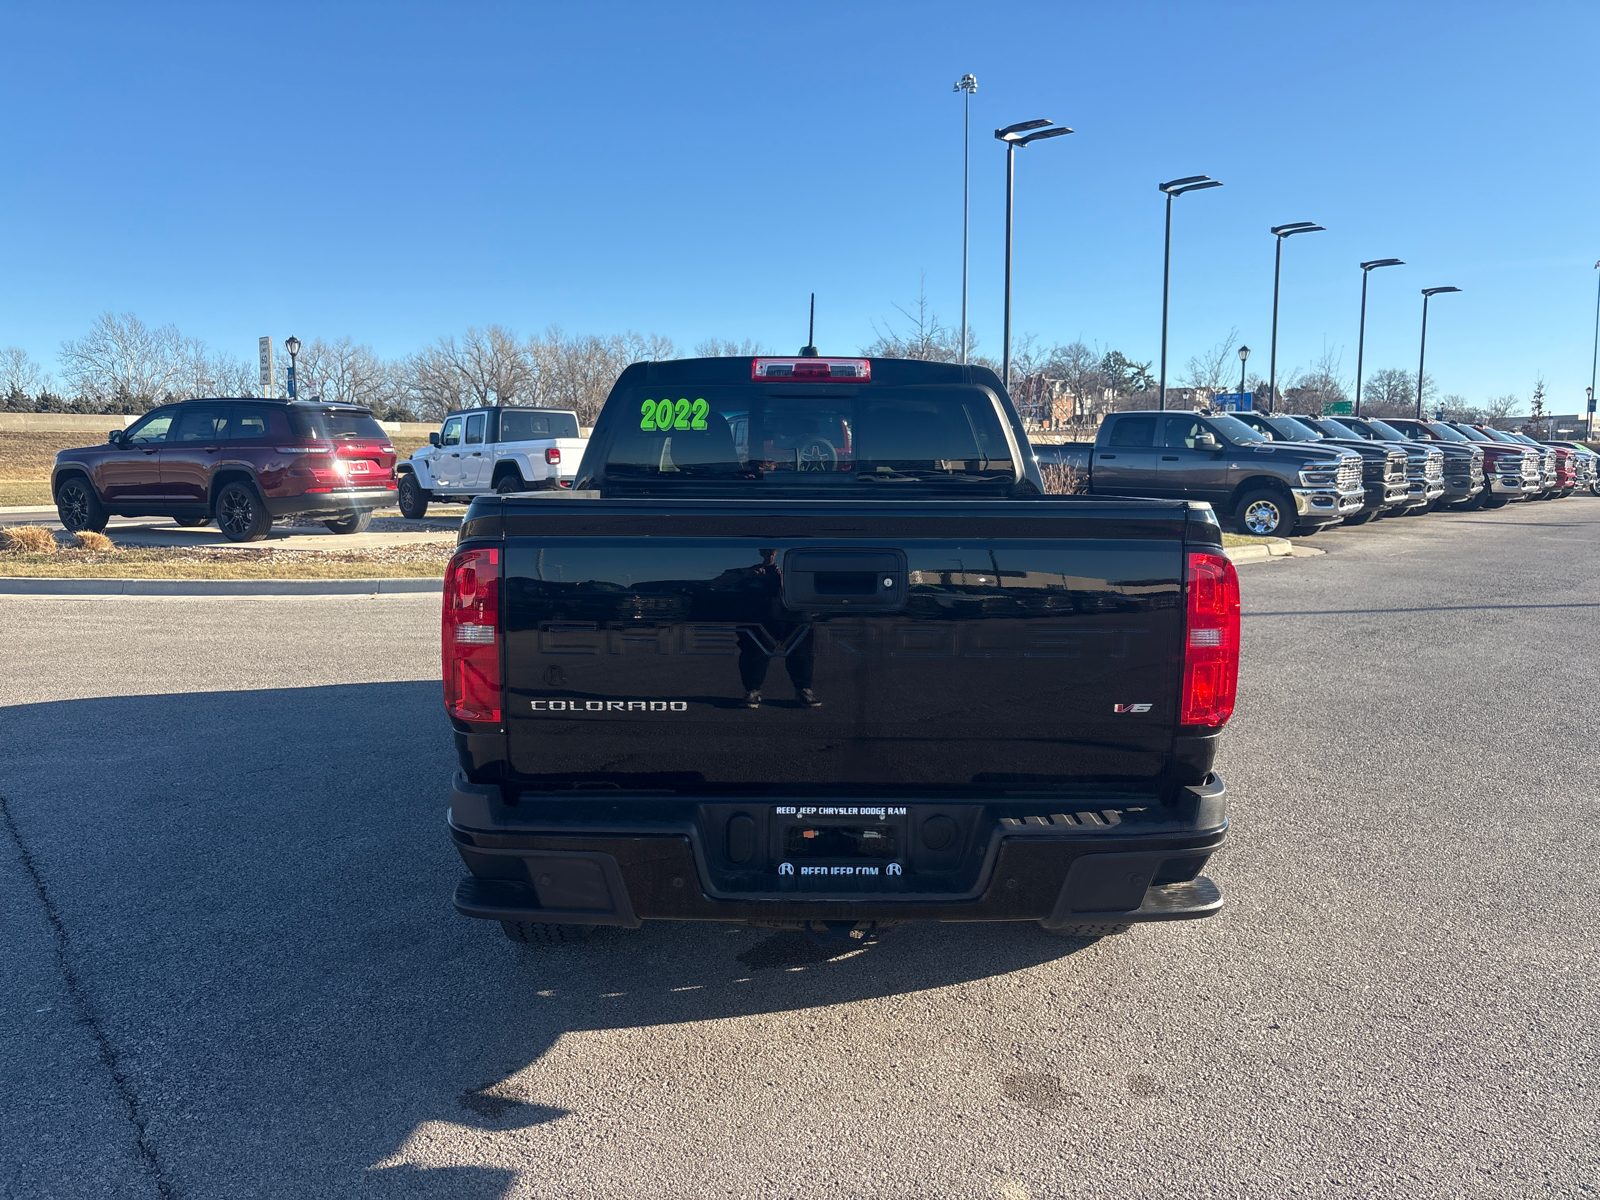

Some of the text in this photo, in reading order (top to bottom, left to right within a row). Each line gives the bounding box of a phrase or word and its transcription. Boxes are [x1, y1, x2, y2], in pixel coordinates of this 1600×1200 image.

[640, 398, 710, 432] 2022
[536, 620, 1150, 658] CHEVROLET
[530, 700, 688, 712] COLORADO
[1113, 703, 1154, 713] V6
[776, 806, 907, 815] REED JEEP CHRYSLER DODGE RAM
